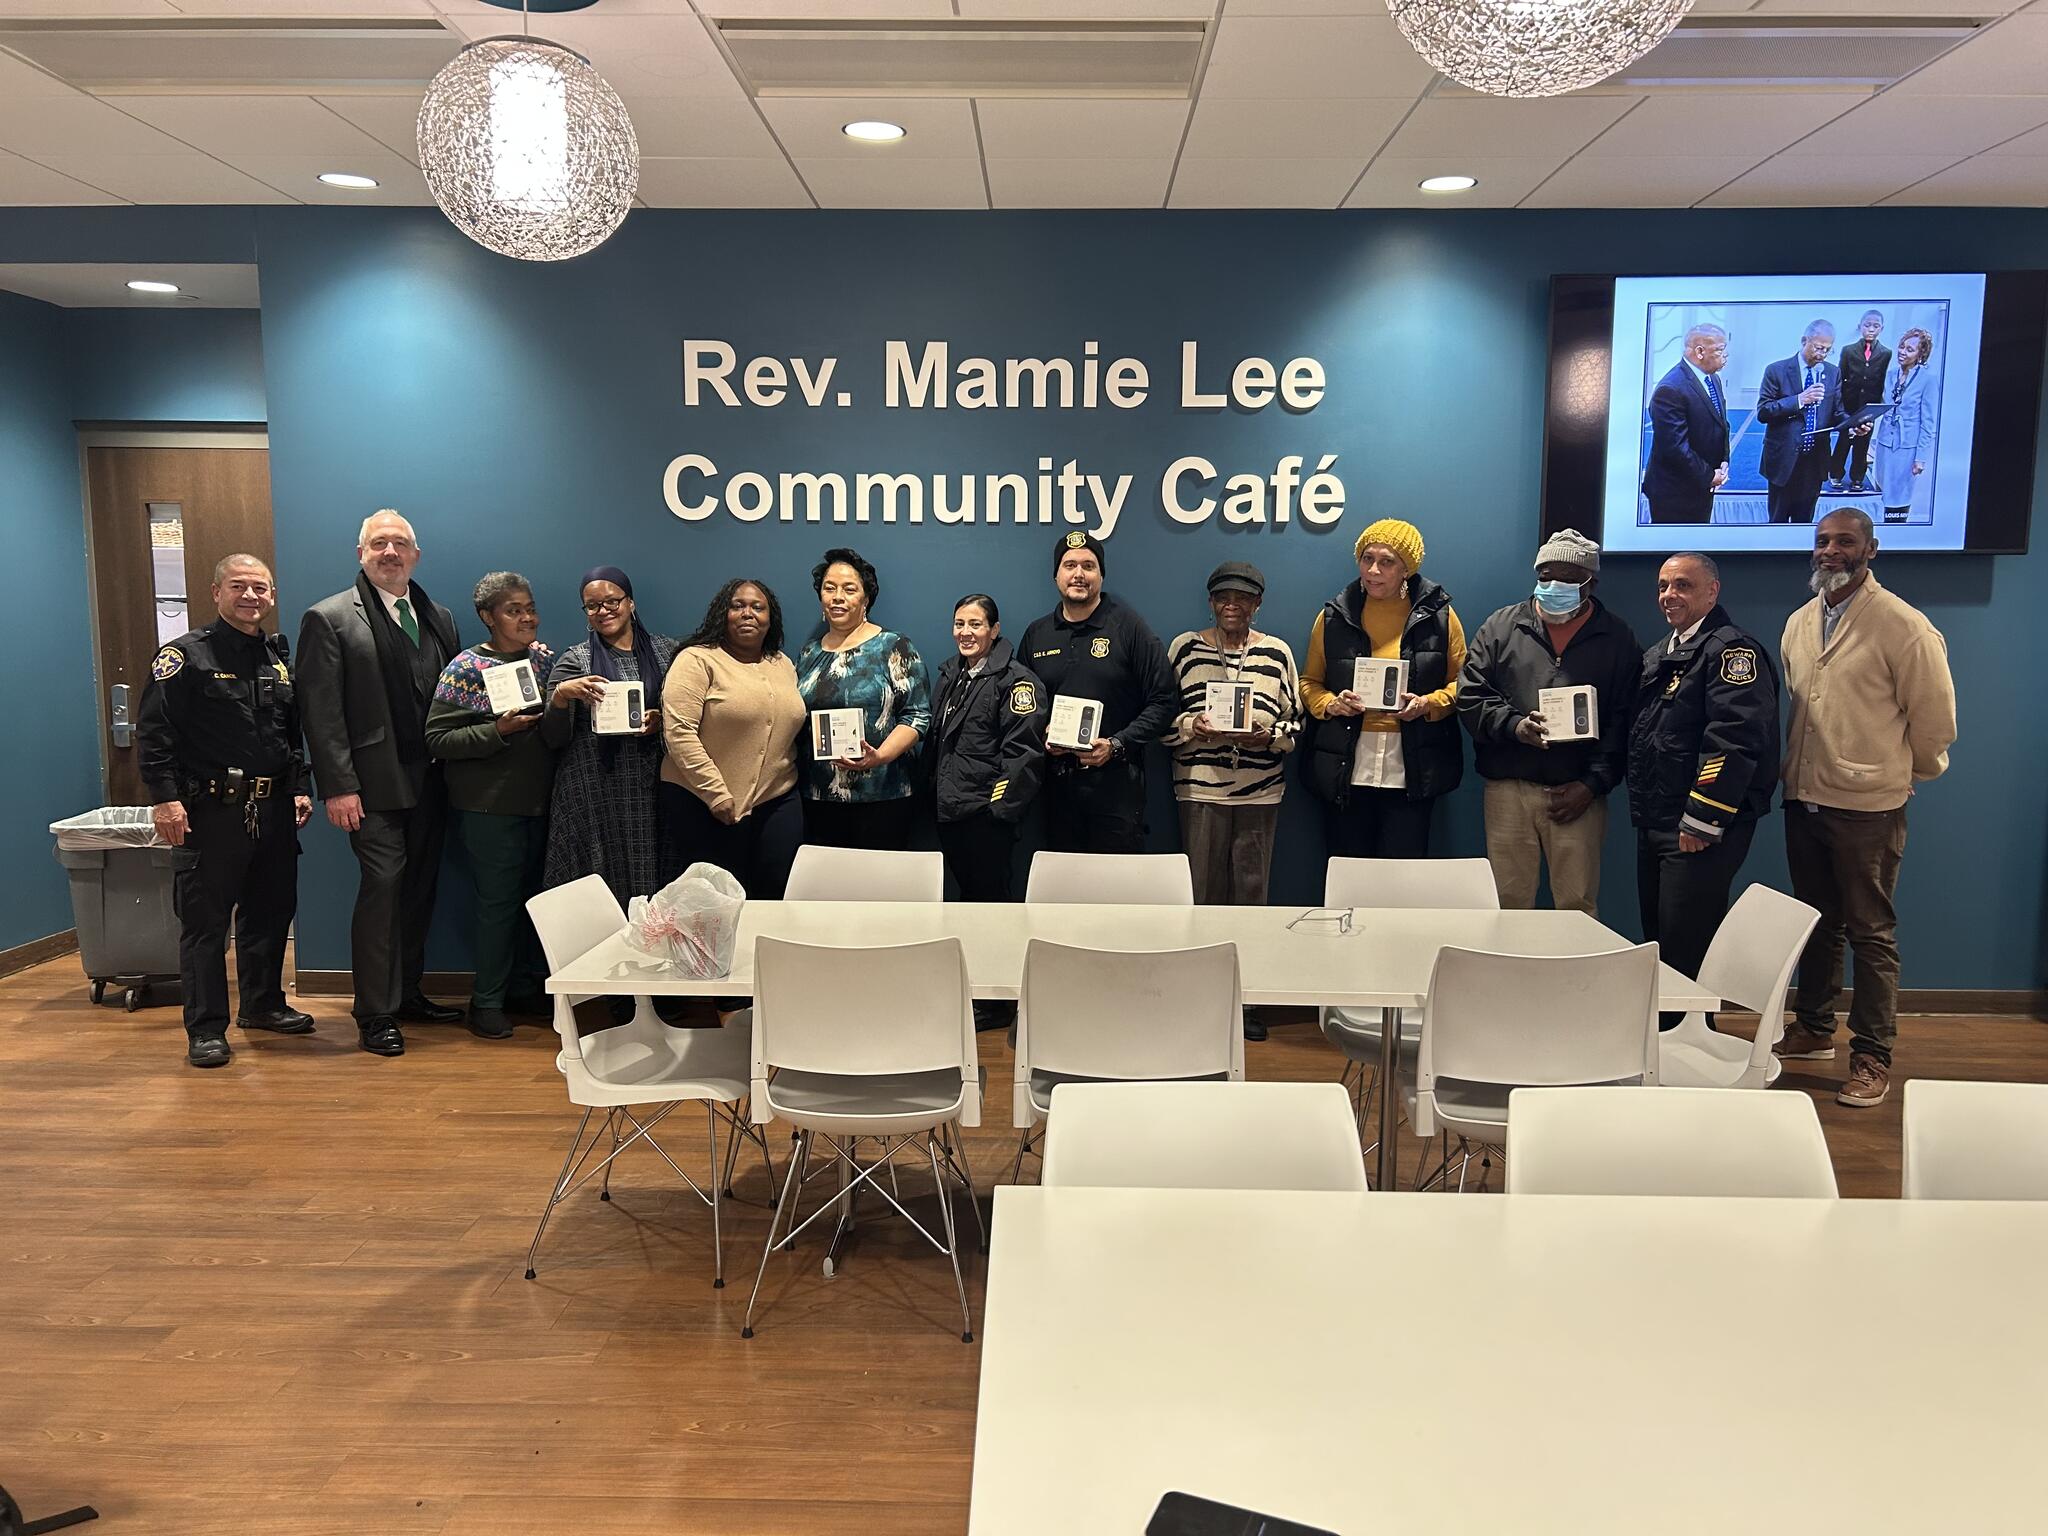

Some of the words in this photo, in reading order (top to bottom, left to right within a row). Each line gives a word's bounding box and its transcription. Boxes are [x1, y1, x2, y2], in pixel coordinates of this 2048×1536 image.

[683, 340, 851, 407] Rev.
[885, 340, 1149, 408] Mamie
[1182, 341, 1326, 408] Lee
[662, 454, 1133, 541] Community
[1161, 455, 1346, 524] Café
